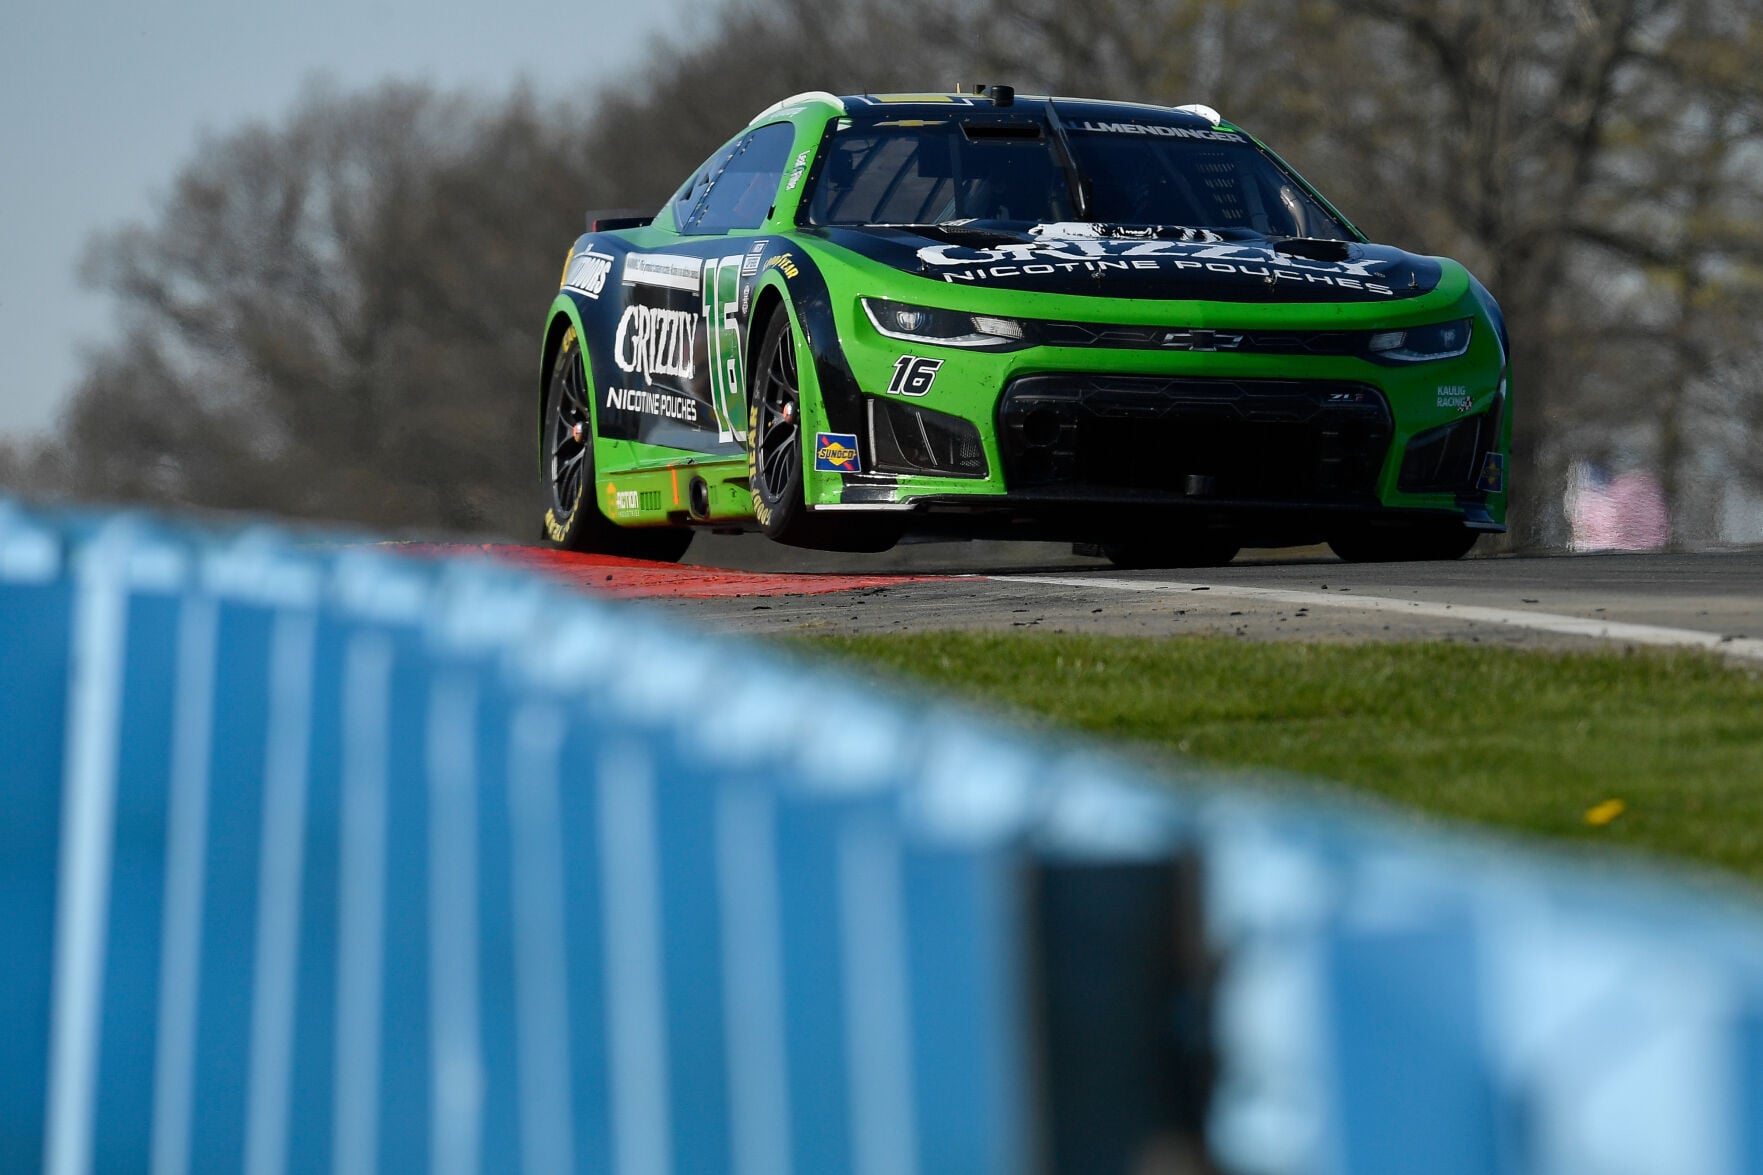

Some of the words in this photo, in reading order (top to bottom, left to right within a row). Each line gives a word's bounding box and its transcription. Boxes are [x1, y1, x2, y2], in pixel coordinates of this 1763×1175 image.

[916, 240, 1388, 277] GRIZZLY
[942, 259, 1161, 283] NICOTINE
[1174, 260, 1394, 296] POUCHES
[614, 303, 699, 386] GRIZZLY
[703, 255, 747, 443] 16
[886, 354, 945, 397] 16
[1437, 385, 1466, 396] KAULIG
[606, 386, 660, 415] NICOTINE
[660, 394, 698, 421] POUCHES
[1436, 397, 1467, 408] RACING
[819, 448, 855, 459] SUNOCO
